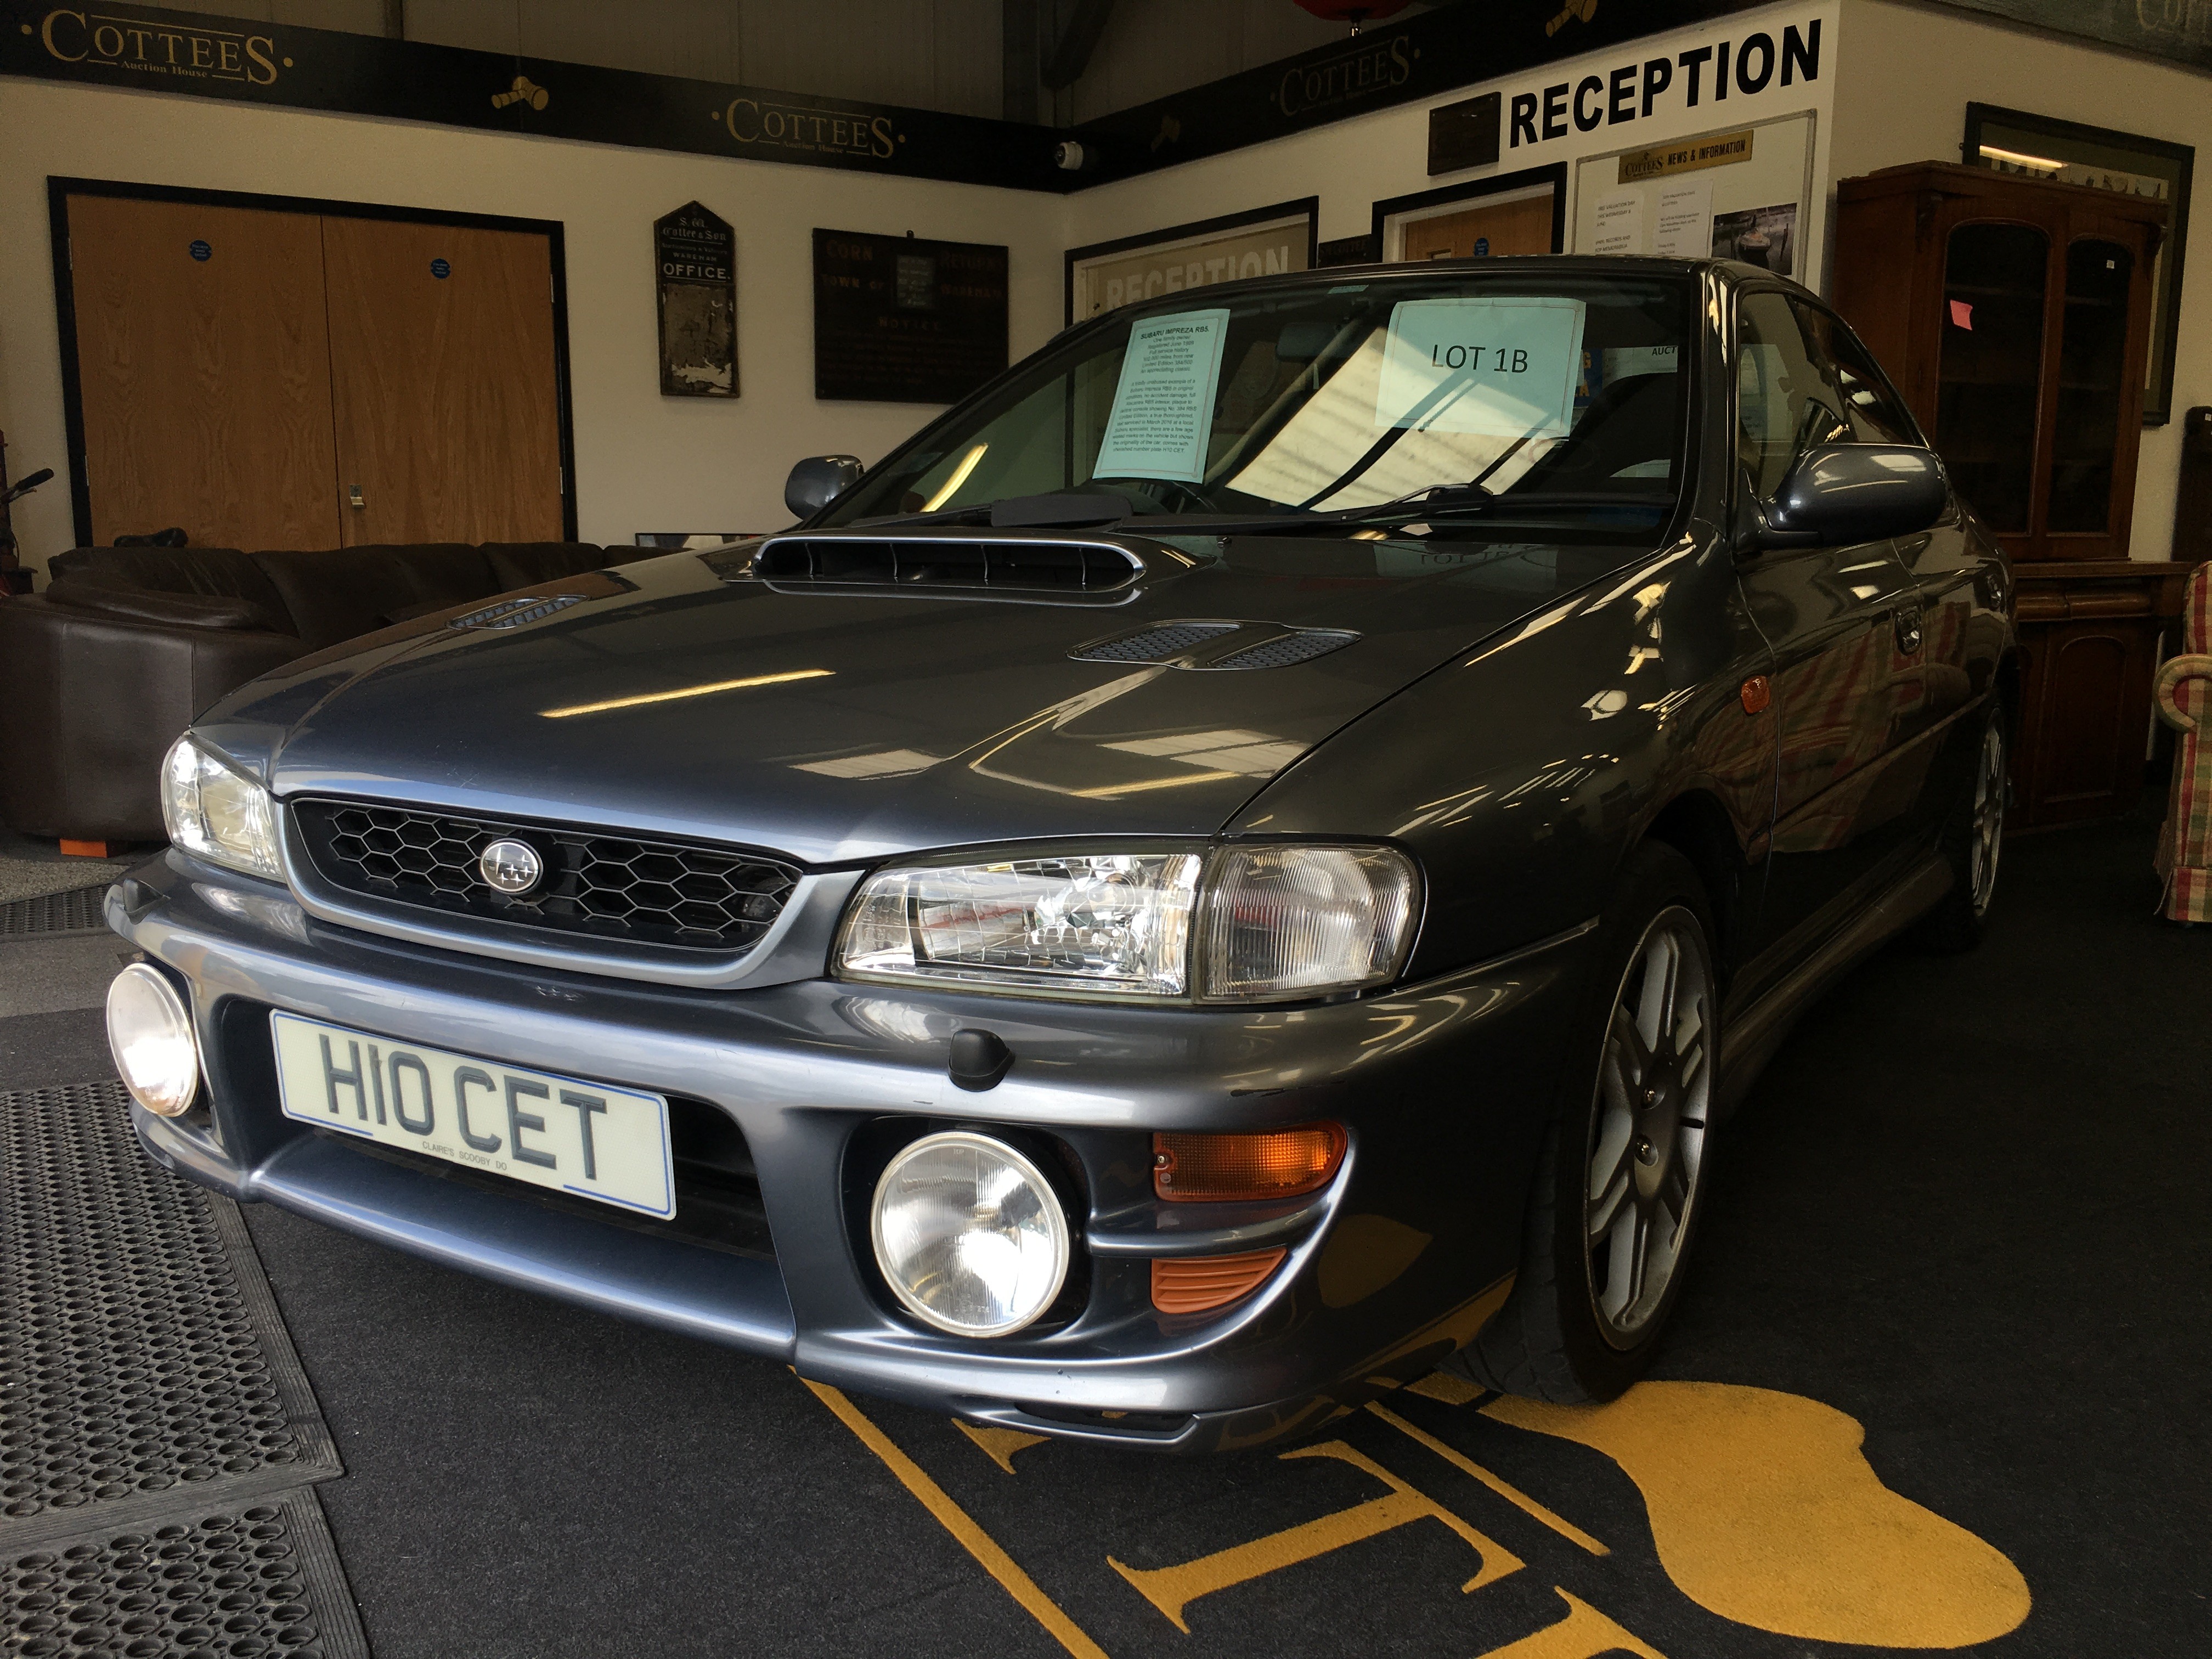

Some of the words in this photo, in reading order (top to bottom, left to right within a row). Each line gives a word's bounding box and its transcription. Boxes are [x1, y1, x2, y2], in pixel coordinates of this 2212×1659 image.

[42, 10, 277, 84] COTTEES
[121, 61, 167, 72] Auction
[172, 66, 207, 78] House
[1280, 35, 1410, 116] COTTEES
[1509, 19, 1821, 148] RECEPTION
[726, 98, 894, 158] COTTEES
[1668, 150, 1686, 165] NEWS
[1690, 149, 1695, 161] &
[1699, 139, 1746, 160] INFORMATION
[705, 230, 726, 241] Son
[826, 239, 873, 261] CORN
[1107, 246, 1288, 311] RECEPTION
[1141, 330, 1164, 339] SUBARU
[1432, 345, 1486, 370] LOT
[1494, 348, 1527, 373] 1B
[454, 1065, 607, 1180] CET
[422, 1141, 454, 1156] CLAIRE'S
[459, 1151, 490, 1166] SCOOBY
[496, 1161, 507, 1170] DO
